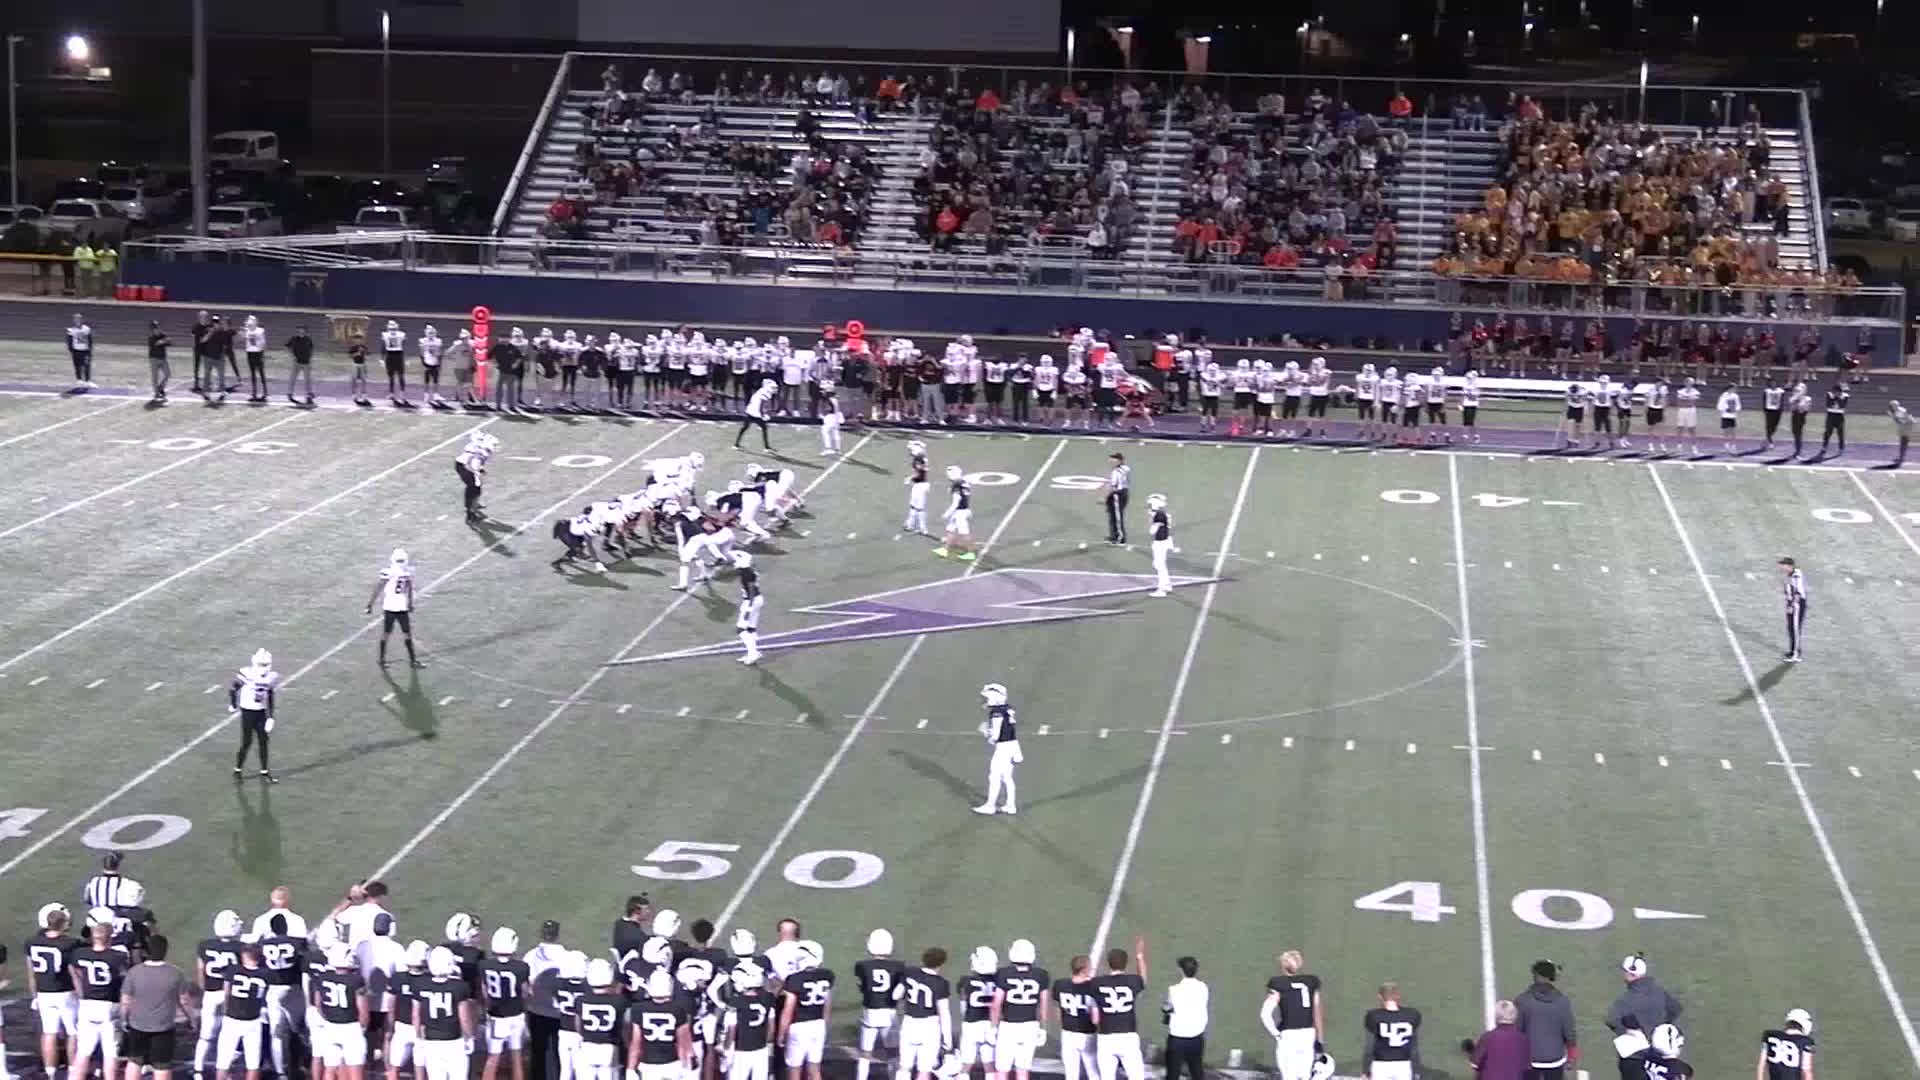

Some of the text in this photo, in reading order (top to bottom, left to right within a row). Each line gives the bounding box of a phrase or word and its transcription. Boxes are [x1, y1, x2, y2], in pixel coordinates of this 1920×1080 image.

[30, 945, 63, 973] 57
[77, 959, 113, 985] 73
[485, 969, 518, 999] 87
[872, 968, 892, 993] 9
[905, 977, 933, 1008] 37
[1005, 978, 1041, 1005] 22
[419, 991, 454, 1019] 74
[1098, 986, 1134, 1014] 32
[1290, 982, 1311, 1008] 7
[581, 1003, 617, 1032] 53
[642, 1012, 676, 1042] 52
[1379, 1022, 1413, 1047] 42
[1767, 1036, 1800, 1068] 38
